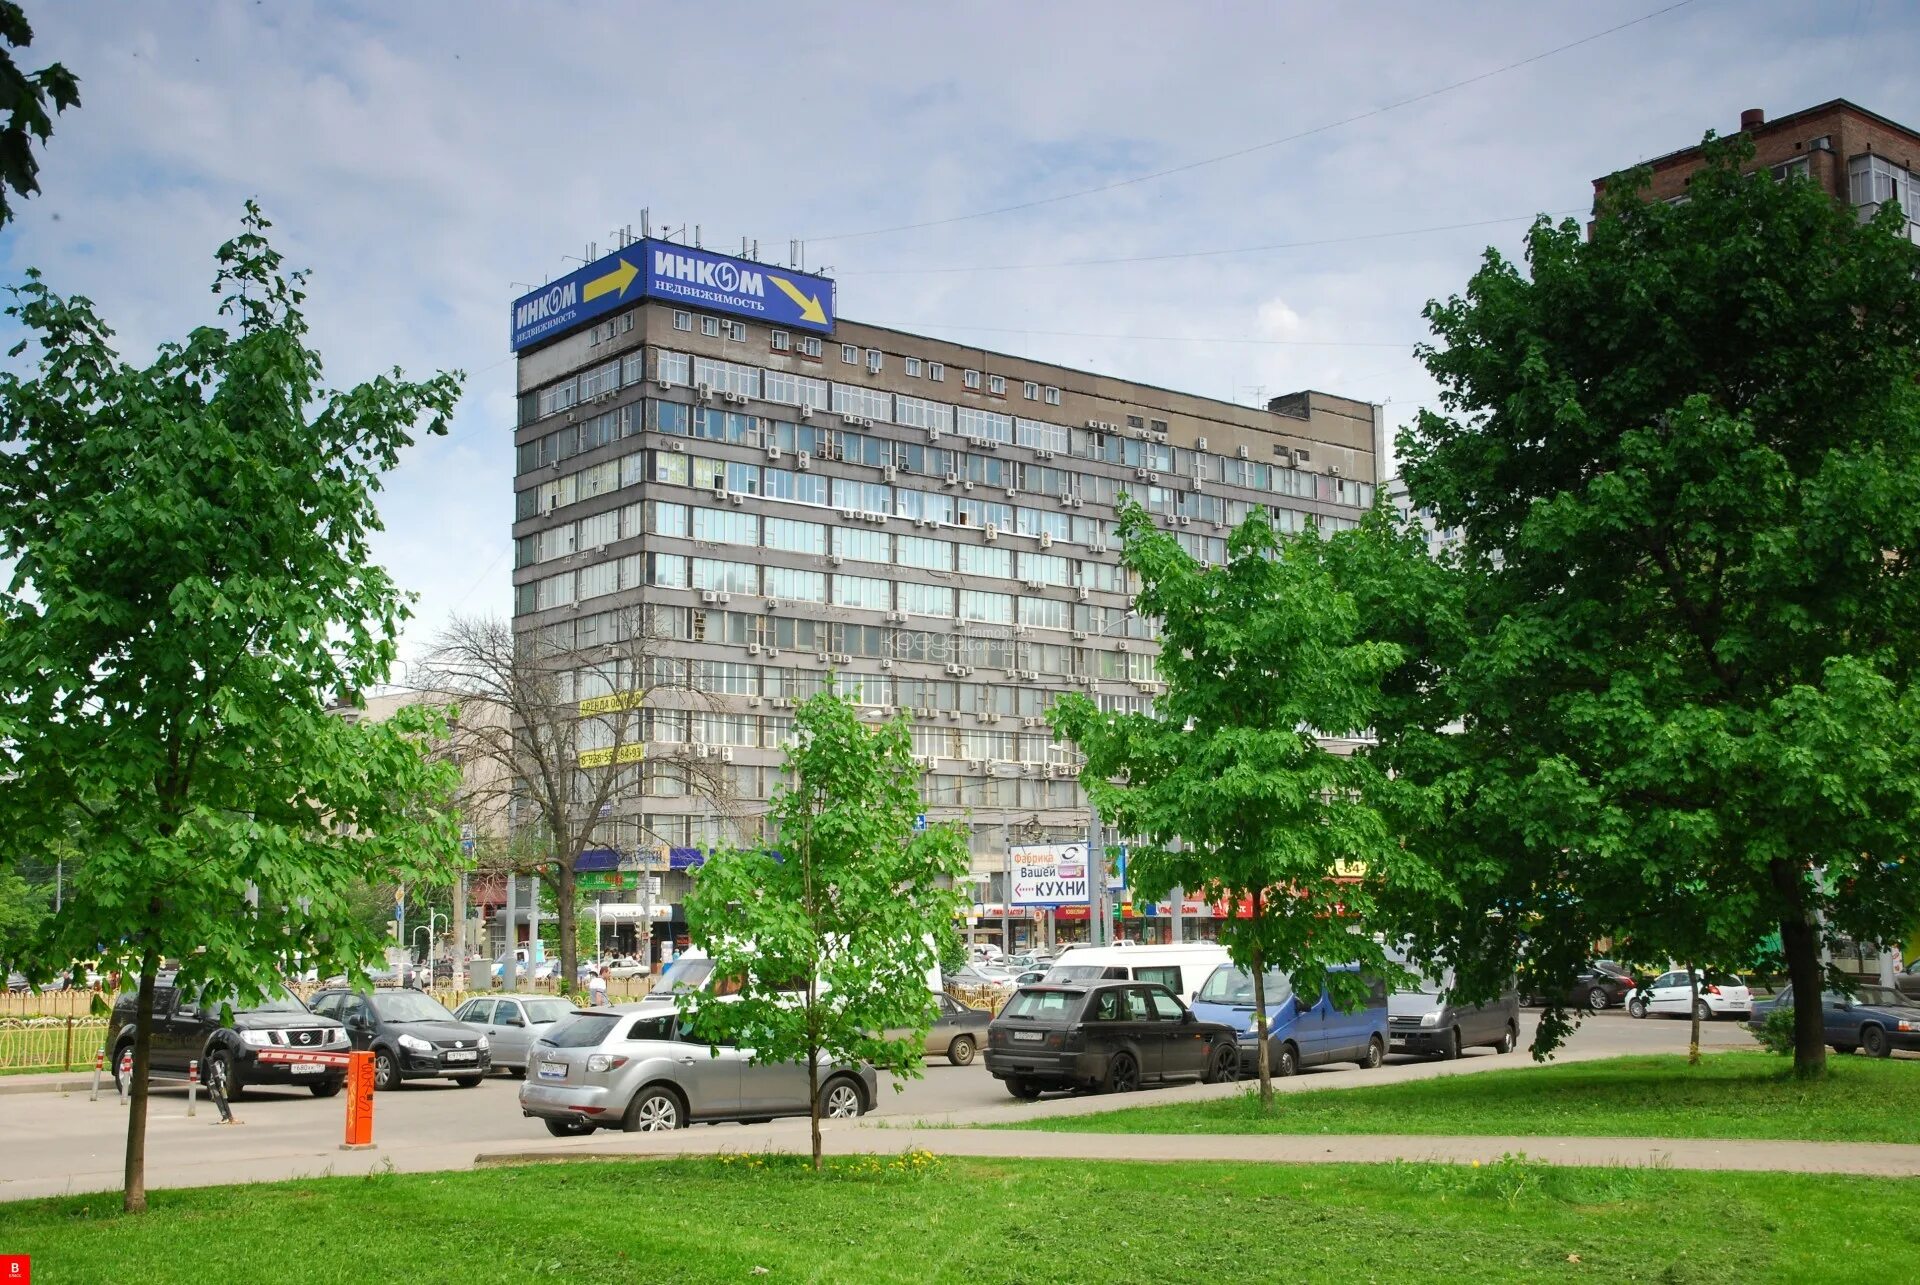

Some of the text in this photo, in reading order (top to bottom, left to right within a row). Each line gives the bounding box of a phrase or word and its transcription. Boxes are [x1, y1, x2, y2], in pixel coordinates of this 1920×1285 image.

[655, 250, 765, 297] ИНКОМ
[516, 281, 577, 330] ИНКОМ
[655, 280, 765, 312] НЕДВИЖИМОСТЬ
[516, 310, 577, 343] НЕДВИЖИМОСТЬ
[1014, 852, 1055, 865] Фабрика
[1020, 866, 1056, 878] Вашей
[1035, 881, 1086, 897] КУХНИ
